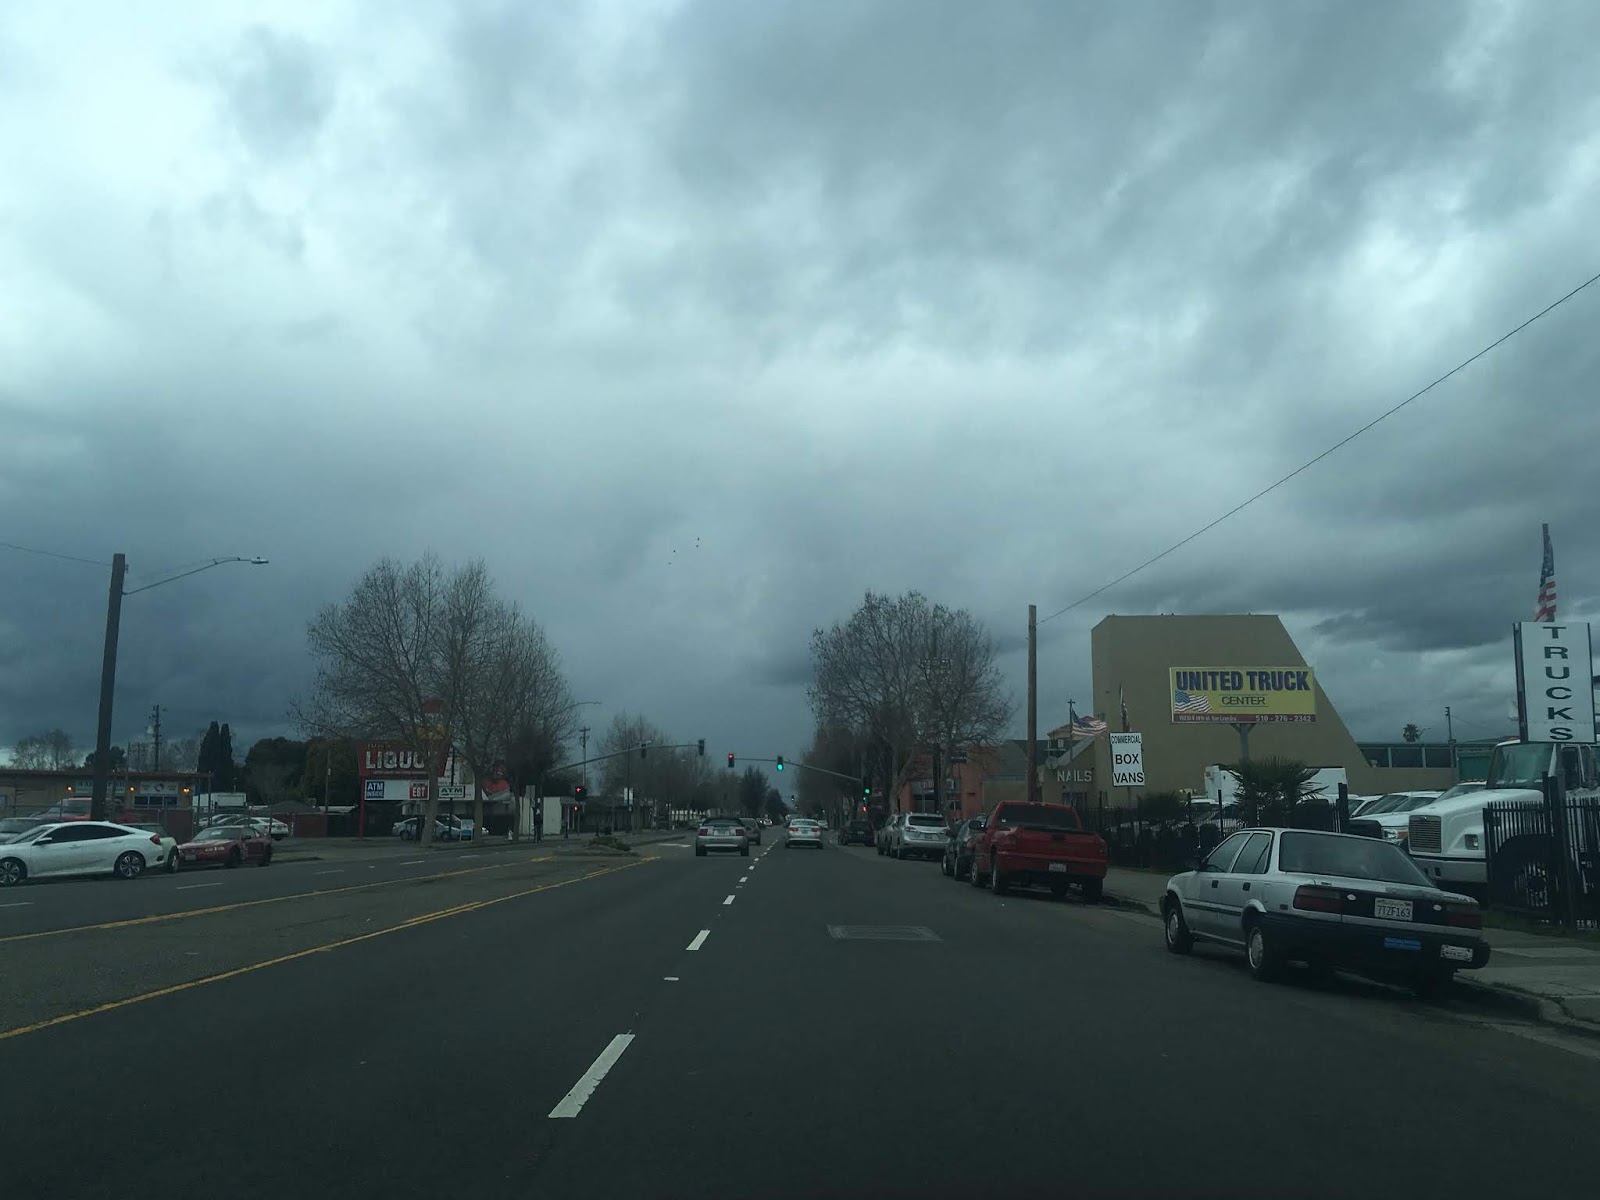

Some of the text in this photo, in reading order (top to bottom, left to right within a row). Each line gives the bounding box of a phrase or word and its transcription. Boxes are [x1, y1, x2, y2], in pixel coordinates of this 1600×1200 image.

[1176, 670, 1311, 691] UNITED TRUCK
[1543, 626, 1574, 741] TRUCKS
[1221, 696, 1266, 706] CENTER
[1111, 735, 1141, 744] COMMERCIAL
[365, 750, 431, 769] LIQUO
[1115, 753, 1140, 765] BOX
[1057, 769, 1093, 783] NAILS
[1113, 772, 1144, 783] VANS
[367, 782, 384, 791] ATM
[1377, 904, 1411, 918] 7TZF163
